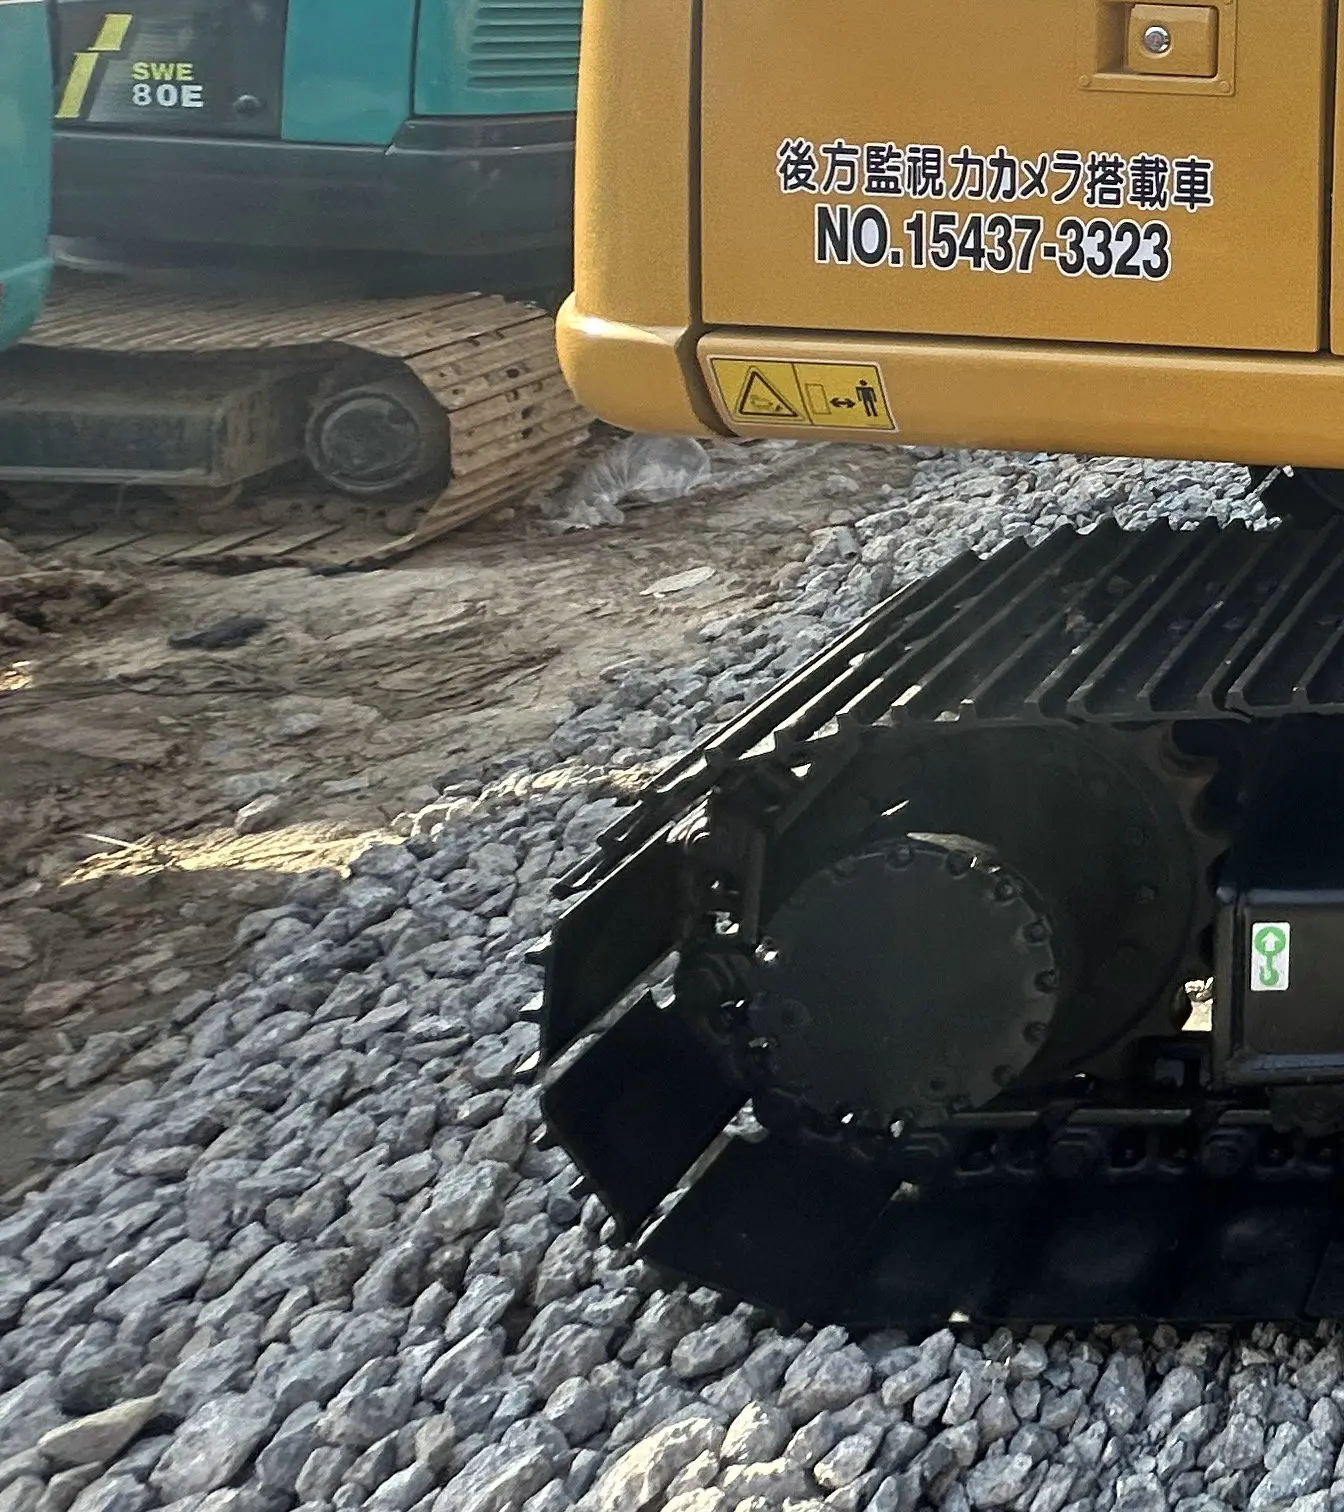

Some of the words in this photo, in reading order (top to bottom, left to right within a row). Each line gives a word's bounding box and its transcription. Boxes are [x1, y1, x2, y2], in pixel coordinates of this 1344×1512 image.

[131, 62, 194, 81] SWE
[131, 83, 204, 108] 80E
[815, 204, 1171, 280] NO.15437-3323
